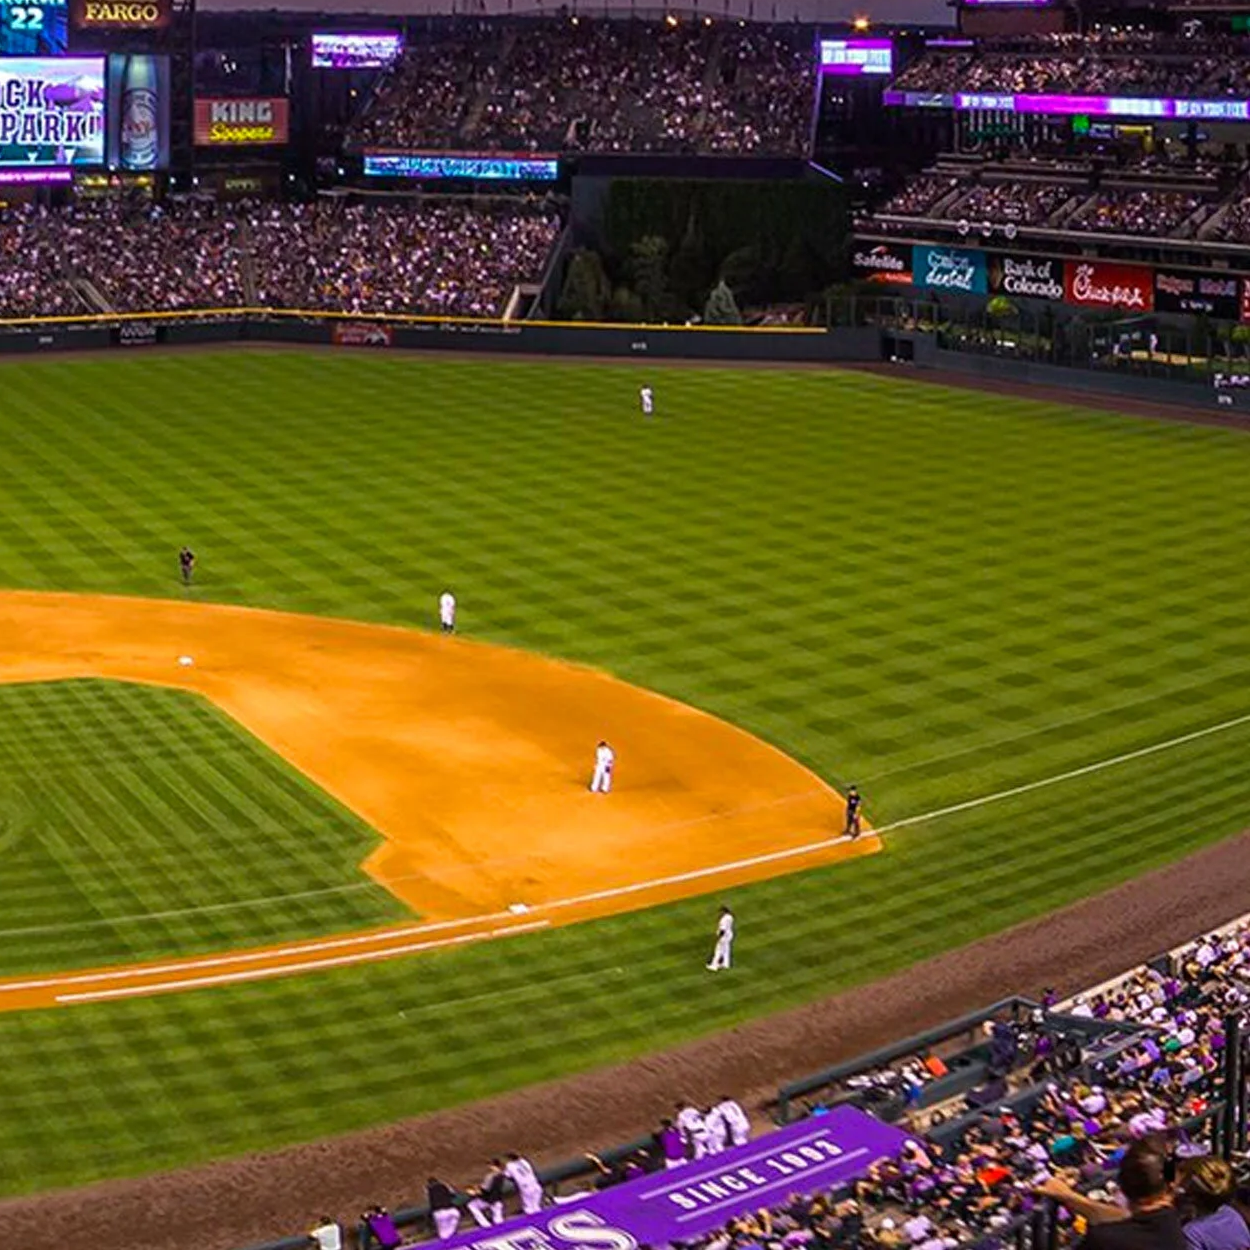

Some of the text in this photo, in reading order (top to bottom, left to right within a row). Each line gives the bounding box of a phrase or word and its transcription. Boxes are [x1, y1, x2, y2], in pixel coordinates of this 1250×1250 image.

[11, 7, 44, 29] 22
[84, 3, 159, 21] FARGO
[211, 101, 272, 123] KING
[1, 112, 95, 142] PARK!
[1003, 257, 1036, 277] Bank
[1003, 276, 1063, 298] Colorado
[668, 1167, 768, 1210] SINCE
